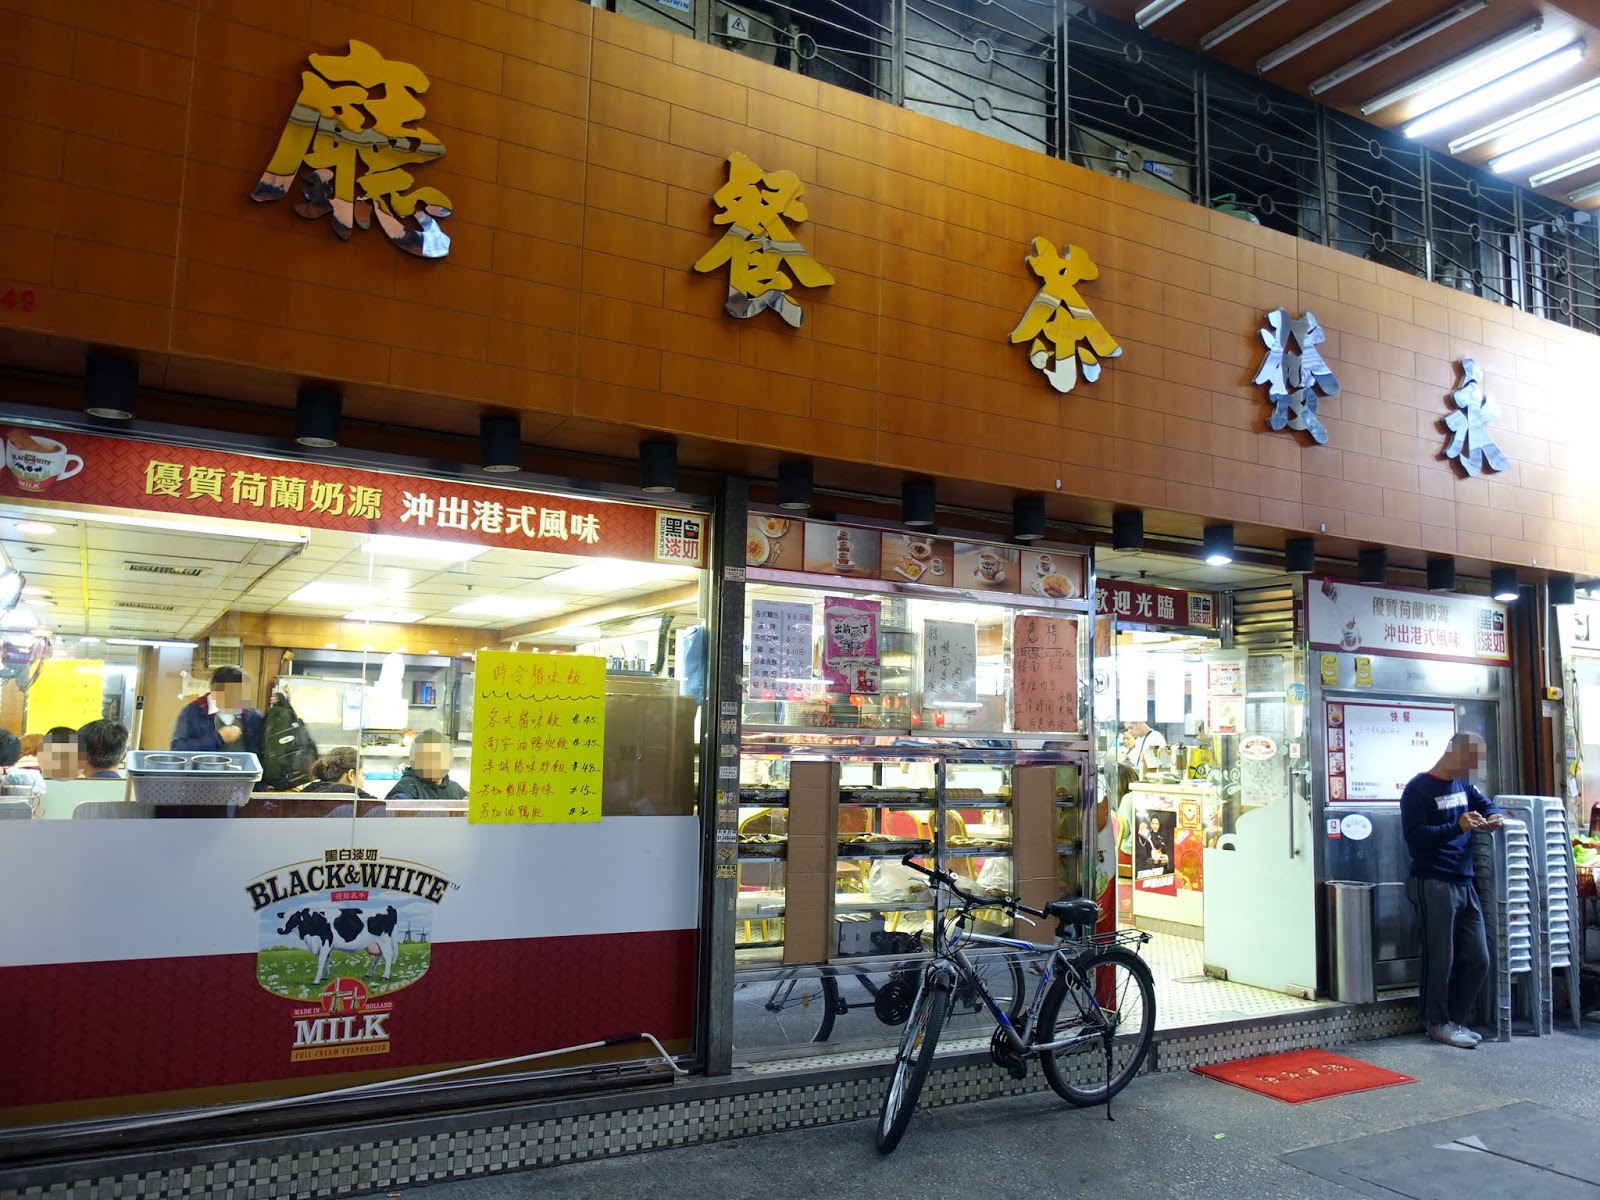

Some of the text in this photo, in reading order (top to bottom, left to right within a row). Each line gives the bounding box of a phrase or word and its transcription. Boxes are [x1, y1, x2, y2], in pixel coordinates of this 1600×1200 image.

[144, 460, 382, 519] 優質荷蘭奶源
[400, 490, 601, 544] 沖出港式風味
[665, 538, 699, 559] 淡奶
[1096, 588, 1174, 620] 歡迎光臨
[1372, 596, 1450, 623] 優質荷蘭奶源
[835, 624, 869, 635] 出前一丁
[1384, 623, 1460, 648] 沖出港式風味
[1481, 631, 1505, 653] 淡奶
[1391, 710, 1411, 723] 快餐
[325, 849, 378, 862] 黑白淡奶
[246, 863, 450, 912] BLACK&WHITE
[365, 1002, 392, 1010] HOLLAND
[293, 1013, 391, 1047] MILK
[295, 1044, 386, 1060] FULL CREAM EVAPORATED
